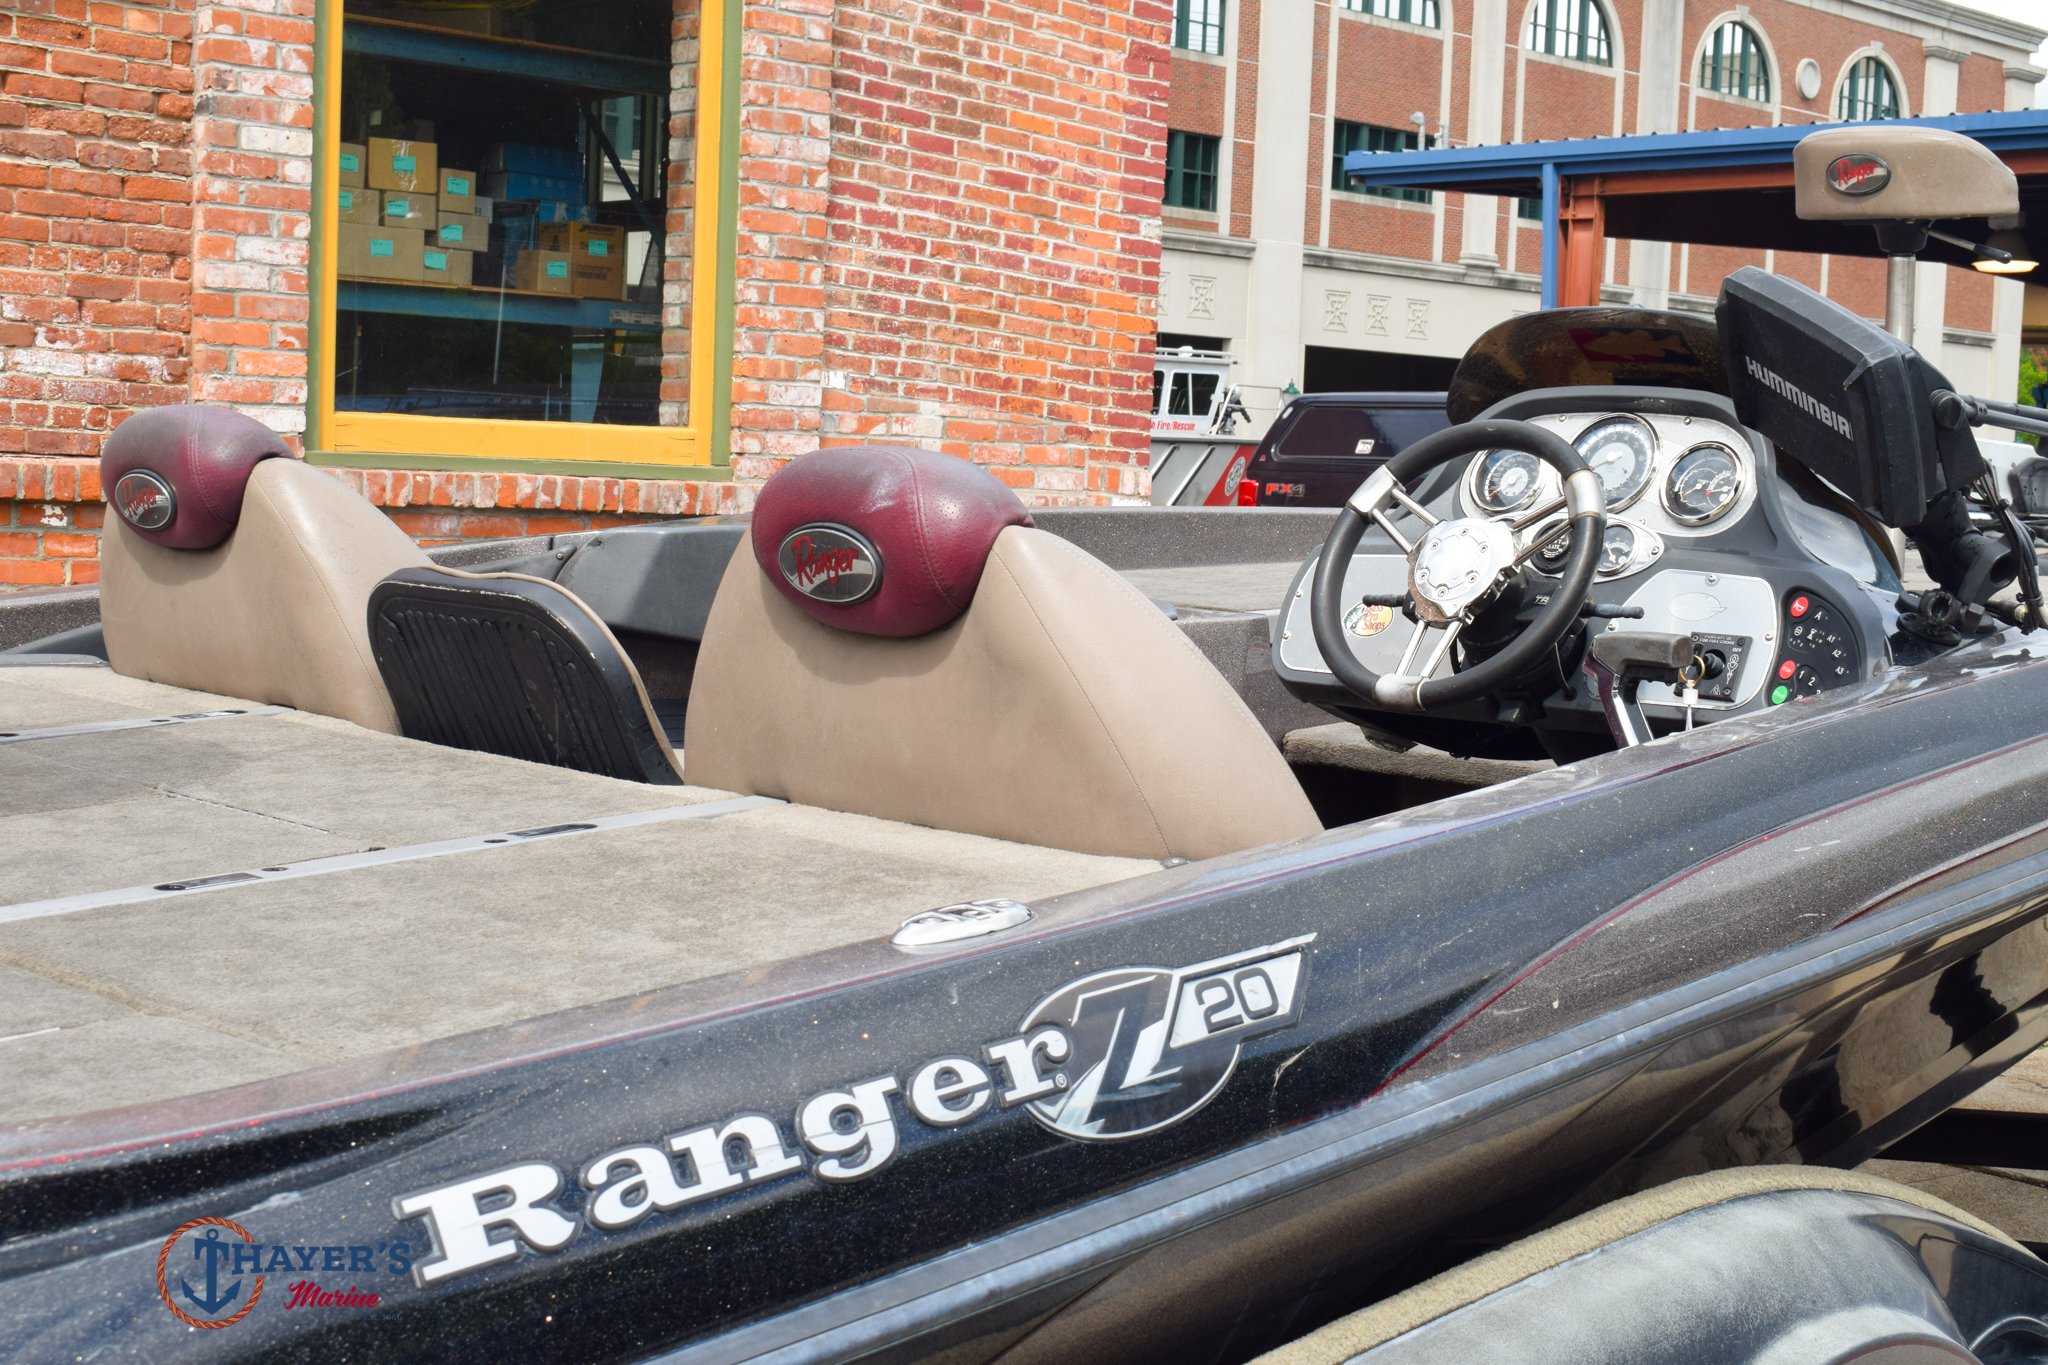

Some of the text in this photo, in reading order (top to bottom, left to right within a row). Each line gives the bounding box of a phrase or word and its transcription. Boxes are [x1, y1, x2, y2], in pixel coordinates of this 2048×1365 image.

[1835, 158, 1878, 188] Ranger
[1745, 355, 1854, 442] HUMMINBIR
[1157, 420, 1196, 431] Fire/Rescue
[1265, 483, 1305, 496] FX4
[121, 479, 160, 519] Ranger
[790, 535, 859, 587] Ranger
[1364, 612, 1378, 621] Pro
[1814, 611, 1823, 621] A
[1361, 620, 1386, 632] Shops
[1826, 634, 1836, 643] A1
[1831, 649, 1842, 658] A2
[1782, 665, 1792, 673] STOP
[1834, 666, 1845, 675] A3
[1798, 670, 1805, 679] 1
[1808, 677, 1816, 687] 2
[394, 1026, 1071, 1285] Ranger
